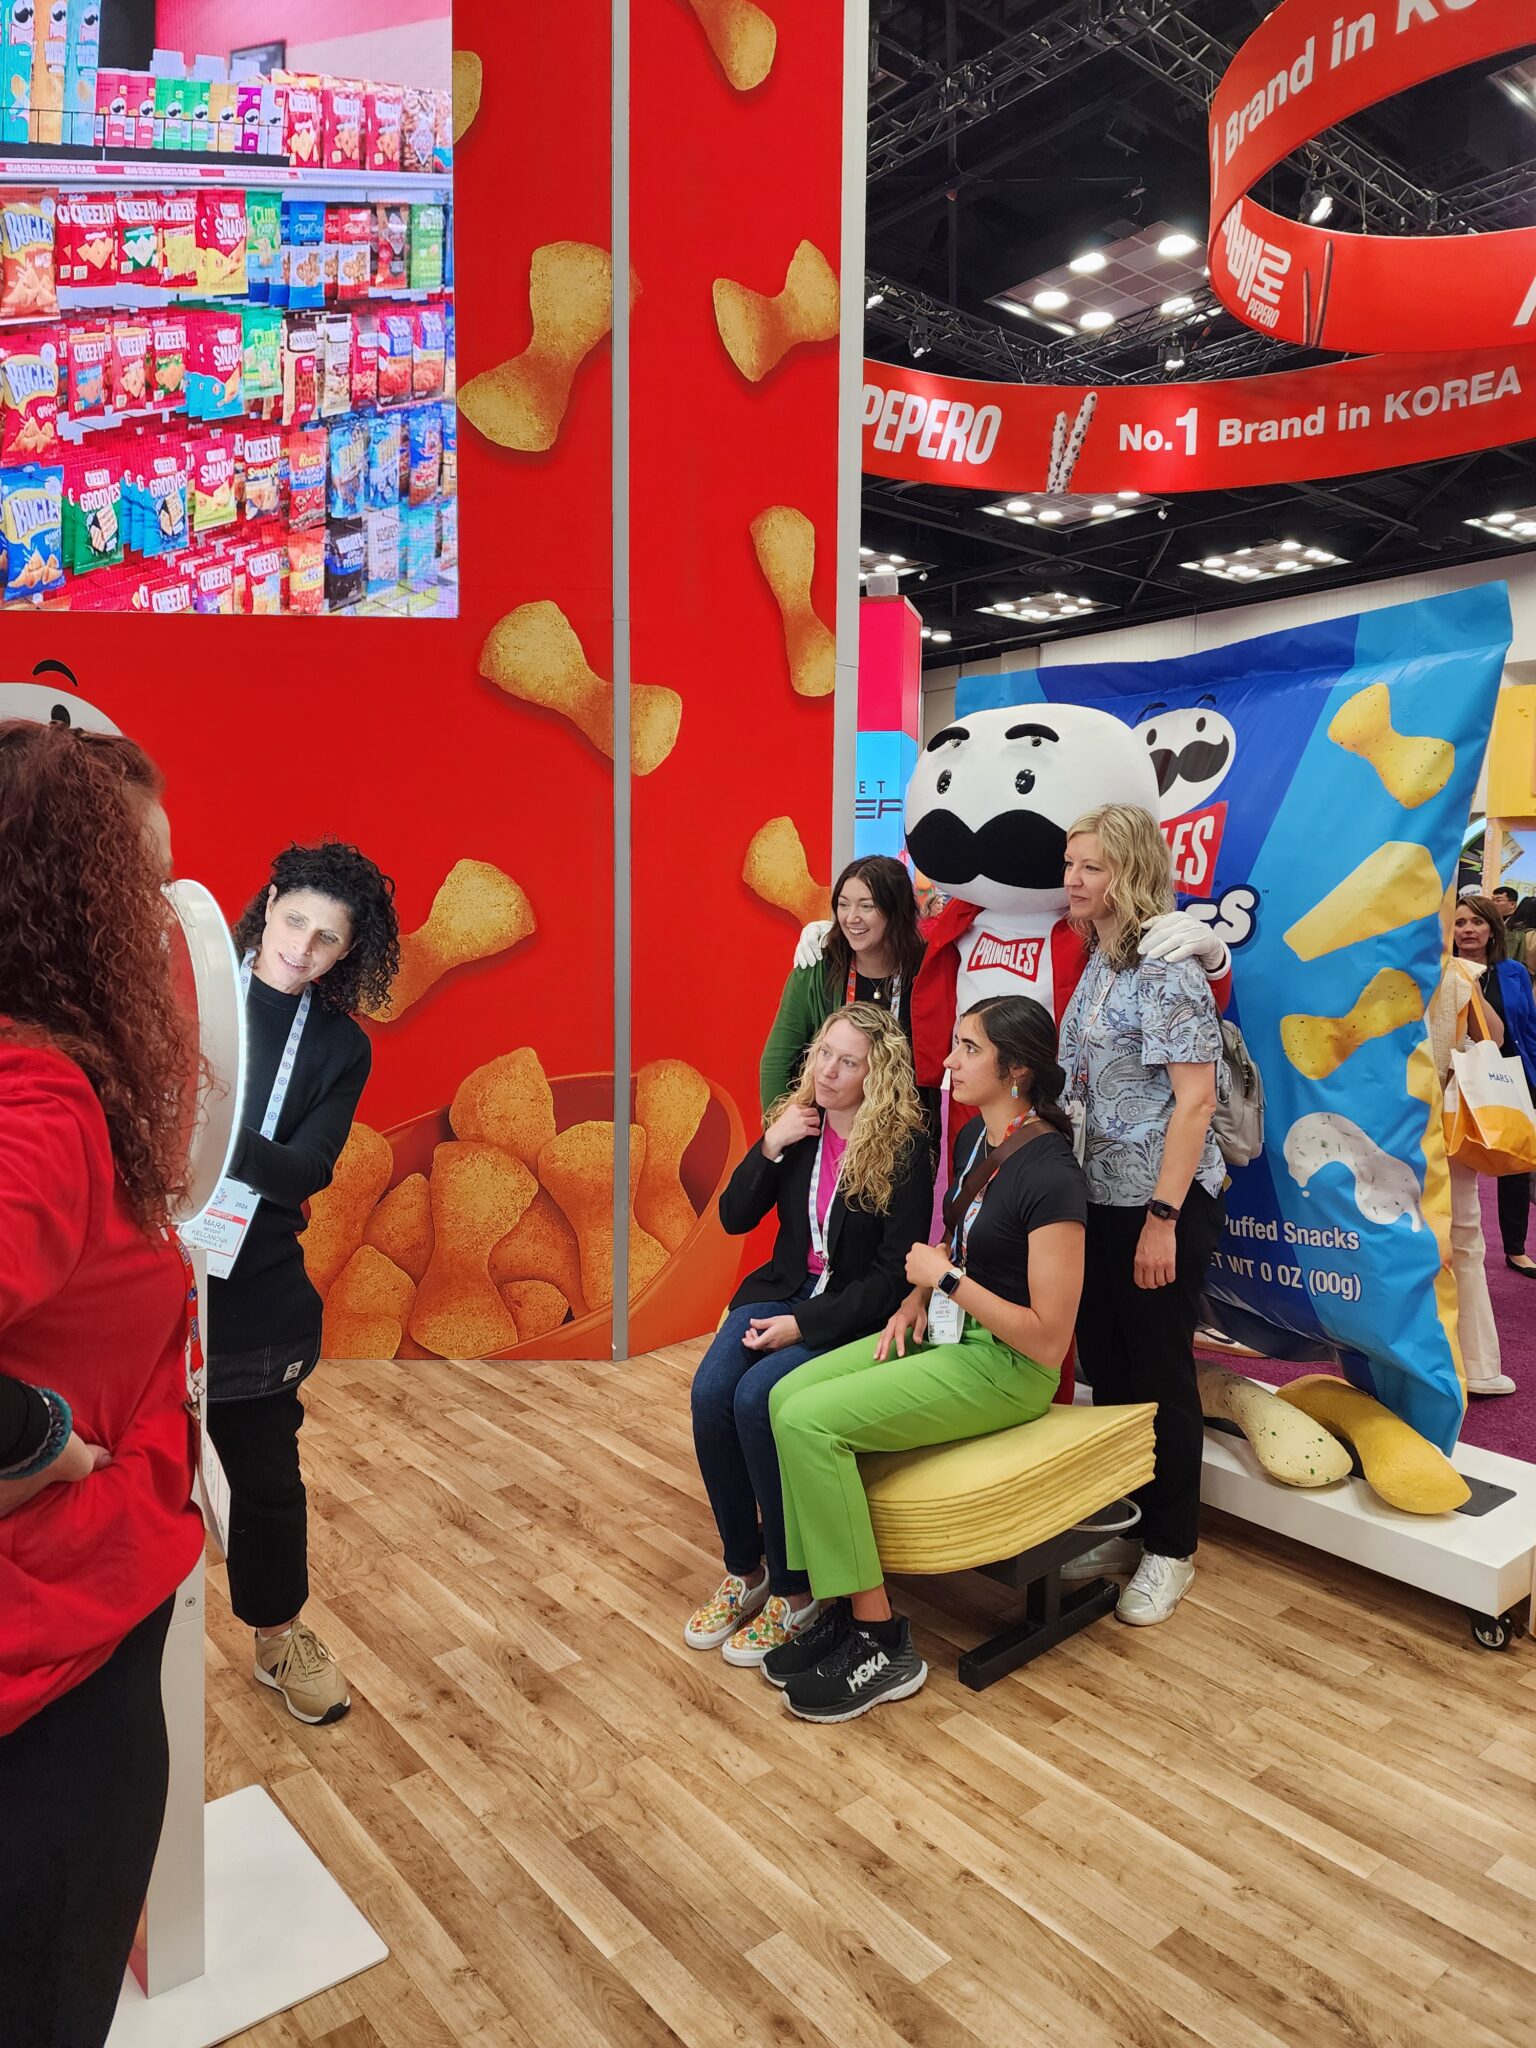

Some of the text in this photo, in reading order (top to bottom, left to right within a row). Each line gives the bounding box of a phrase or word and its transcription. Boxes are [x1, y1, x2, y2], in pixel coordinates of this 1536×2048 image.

[1225, 35, 1315, 167] Brand
[1330, 12, 1376, 70] in
[1246, 297, 1280, 329] PEPERO
[862, 384, 1003, 465] PEPERO
[1218, 404, 1326, 448] Brand
[1338, 402, 1371, 431] in
[1383, 365, 1522, 424] KOREA
[80, 482, 122, 513] GROOVES
[970, 936, 1039, 976] PRINGLES
[192, 1229, 228, 1245] KELLANOVA
[203, 1218, 226, 1231] MARA
[1225, 1214, 1360, 1250] uffed Snacks
[1210, 1251, 1223, 1269] T
[1227, 1254, 1255, 1279] WT
[1277, 1264, 1304, 1288] OZ
[1309, 1269, 1363, 1301] (00g)
[846, 1651, 892, 1693] HOKA
